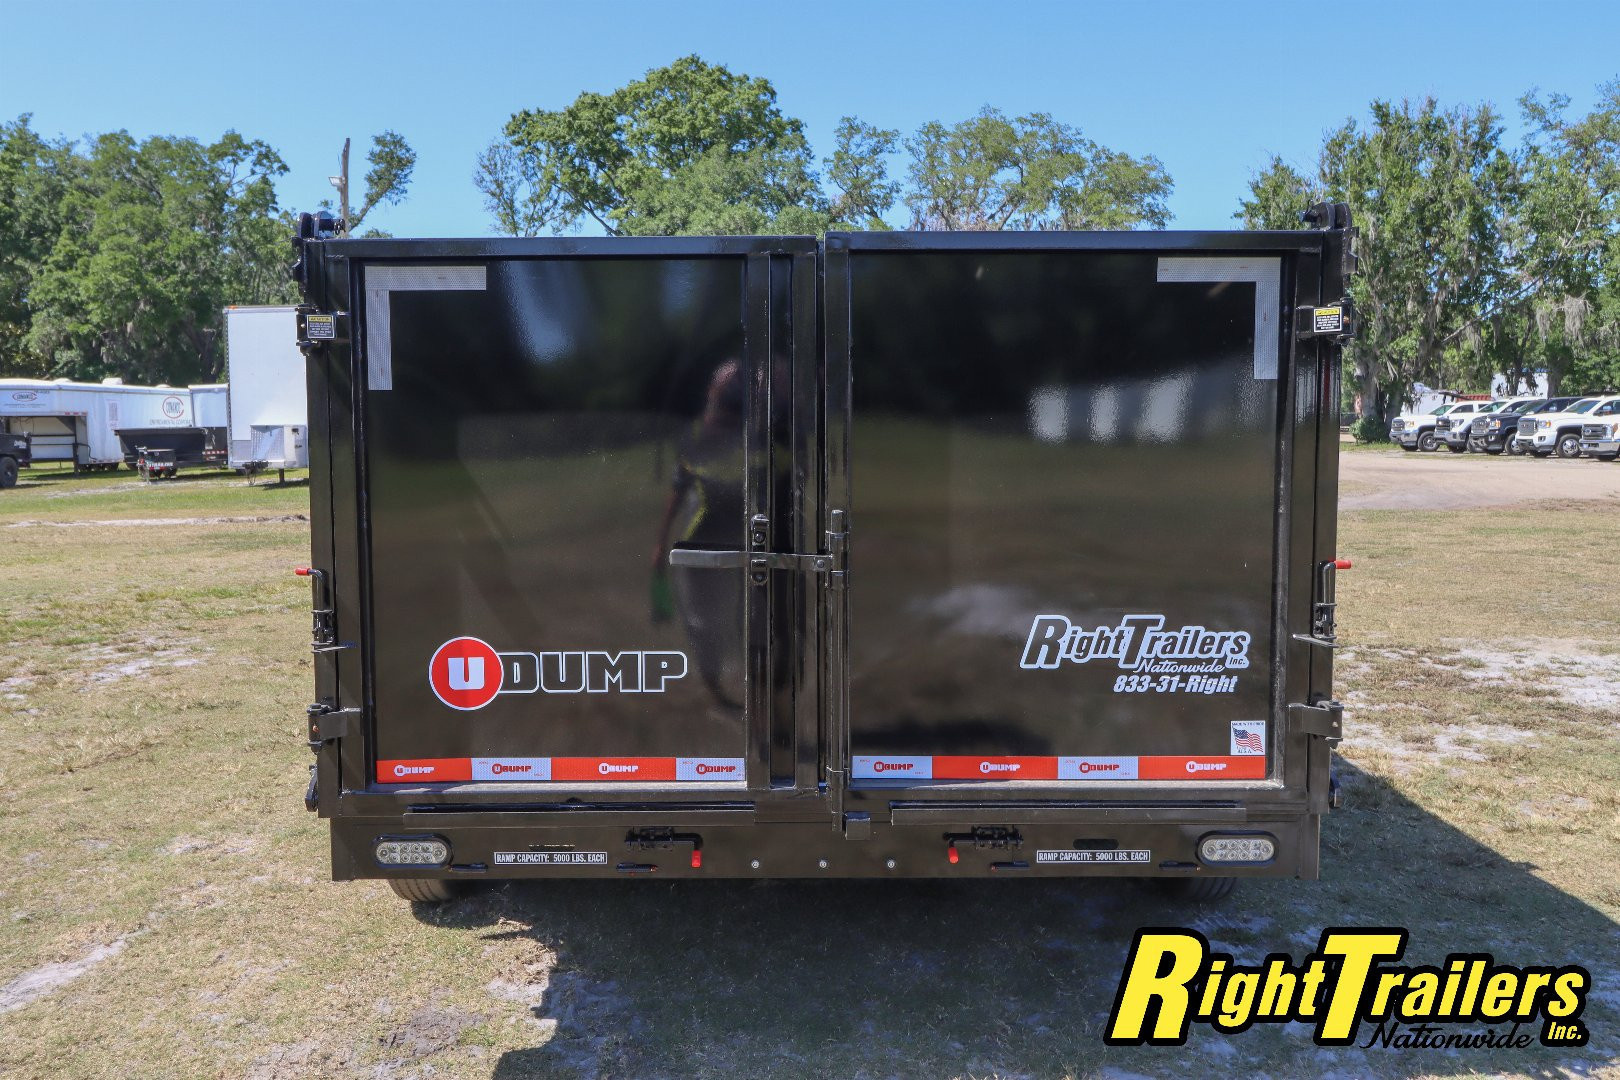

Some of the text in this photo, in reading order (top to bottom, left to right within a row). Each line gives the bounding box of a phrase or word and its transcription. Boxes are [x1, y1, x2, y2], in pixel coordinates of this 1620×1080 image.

[1021, 616, 1249, 667] Right Trailers Inc.
[1133, 659, 1226, 673] Nationwide
[1113, 675, 1238, 695] 833-31-Right
[496, 853, 605, 863] RAMP CAPACITY: 5000 LBS. EACH
[1038, 851, 1148, 861] RAMP CAPACITY: 5000 LBS. EACH
